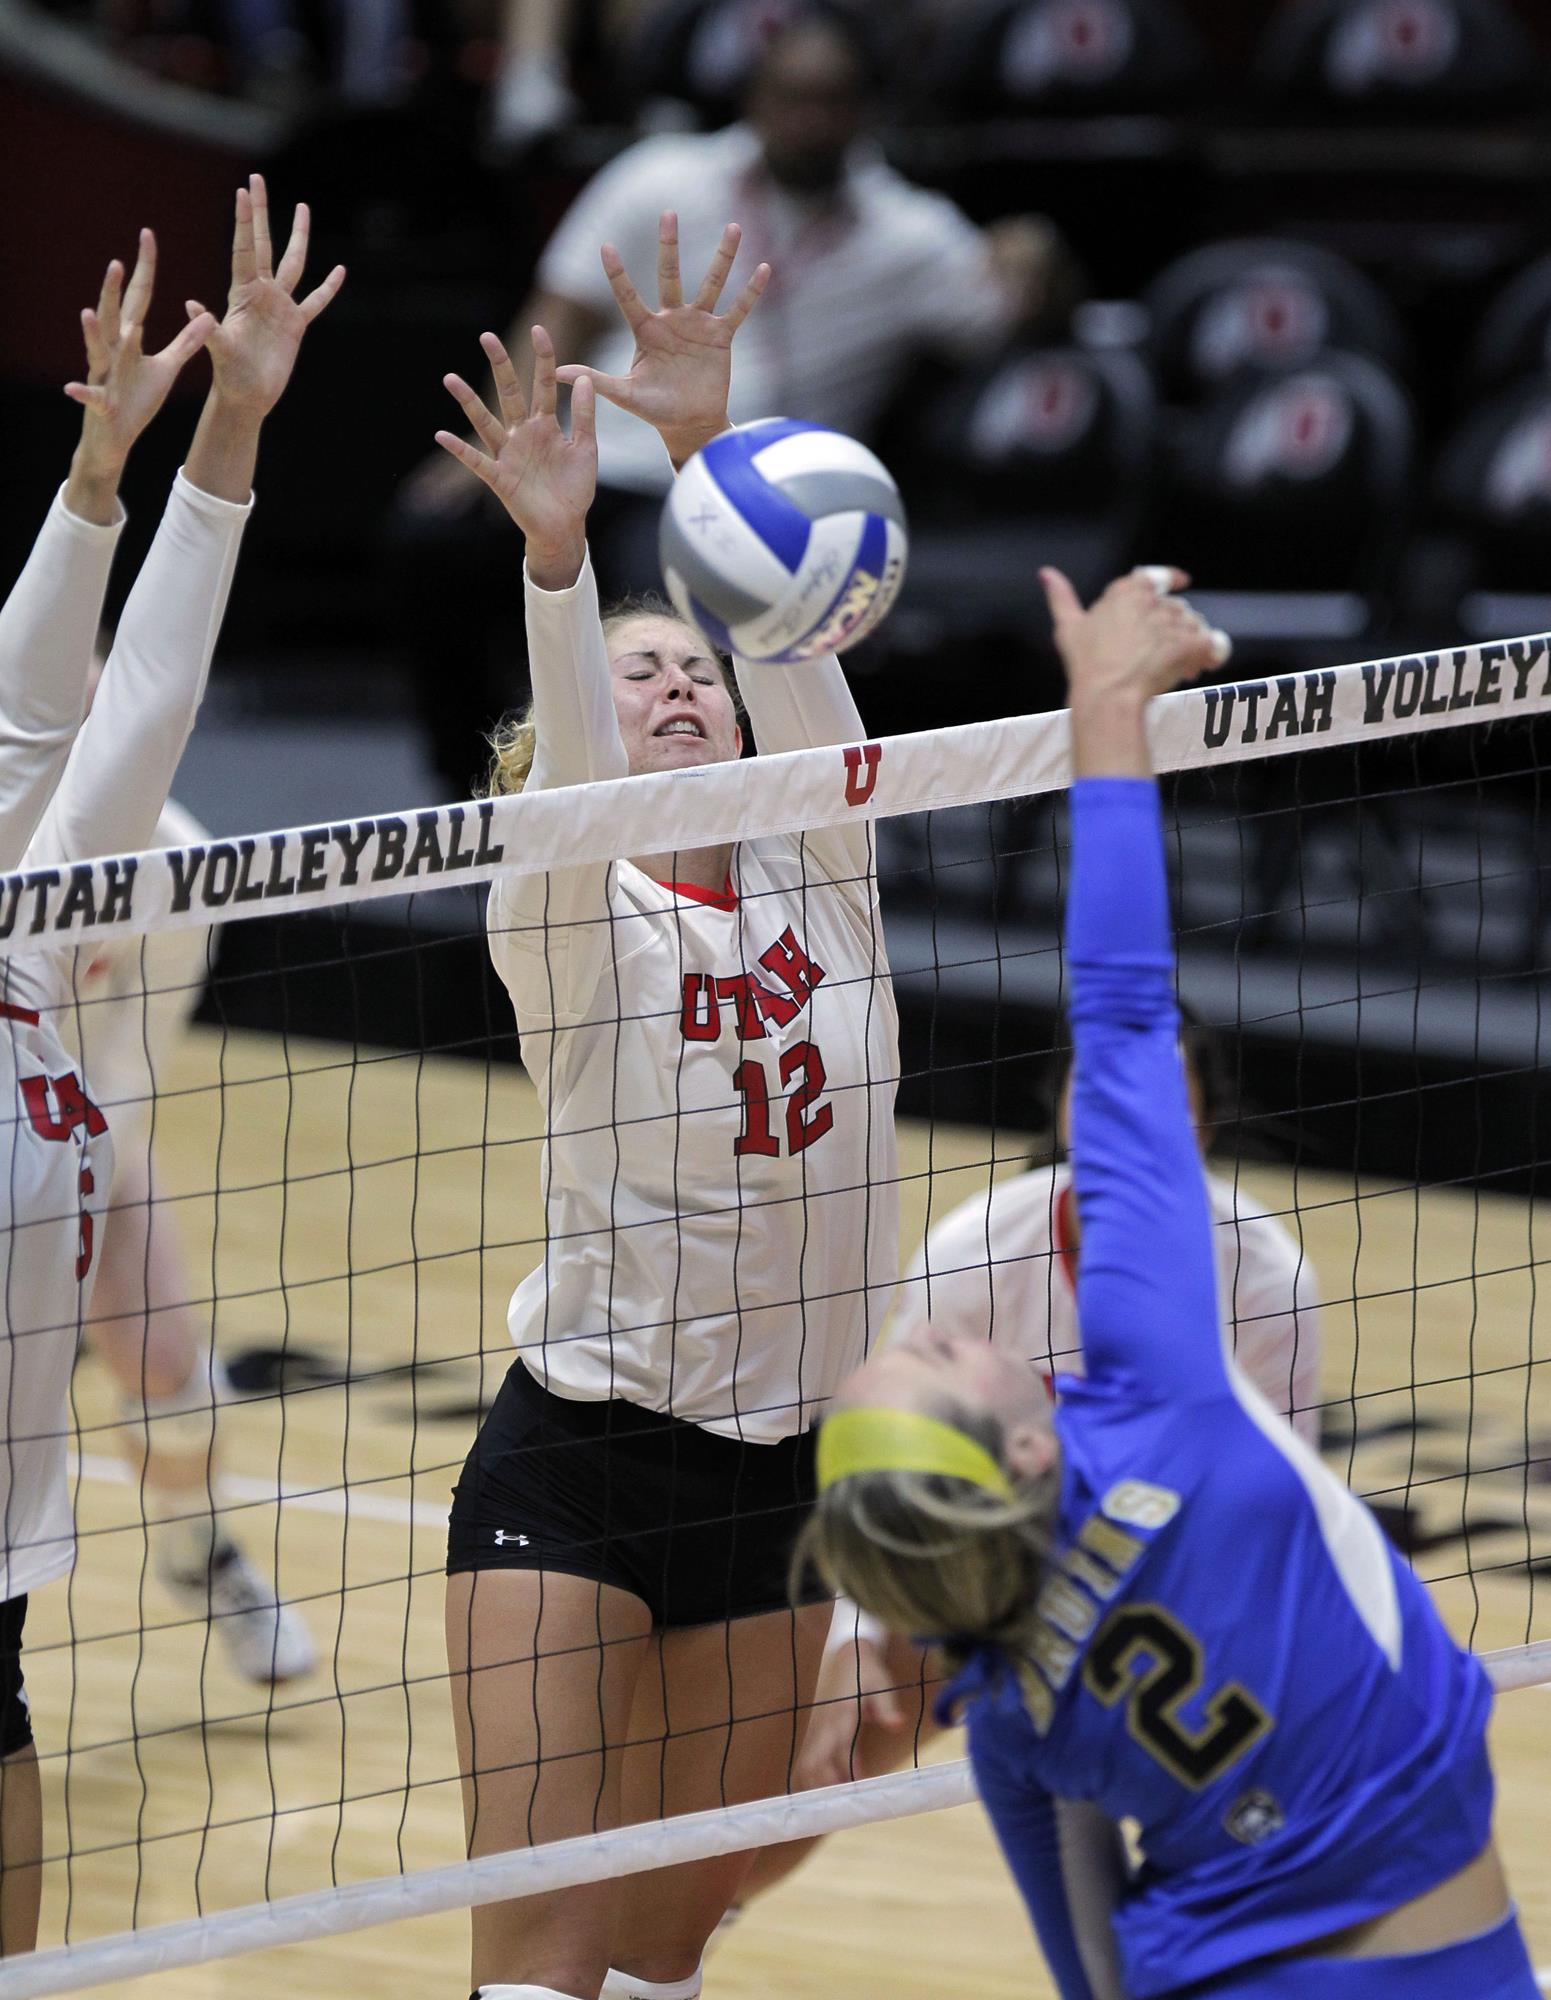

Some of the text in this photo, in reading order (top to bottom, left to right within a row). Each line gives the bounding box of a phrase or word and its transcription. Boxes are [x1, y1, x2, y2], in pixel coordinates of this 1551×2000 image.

[1203, 637, 1551, 748] UTAH VOLLEY
[842, 743, 882, 806] U
[167, 802, 504, 912] VOLLEYBALL
[732, 1040, 833, 1157] 12
[1083, 1602, 1276, 1791] 2
